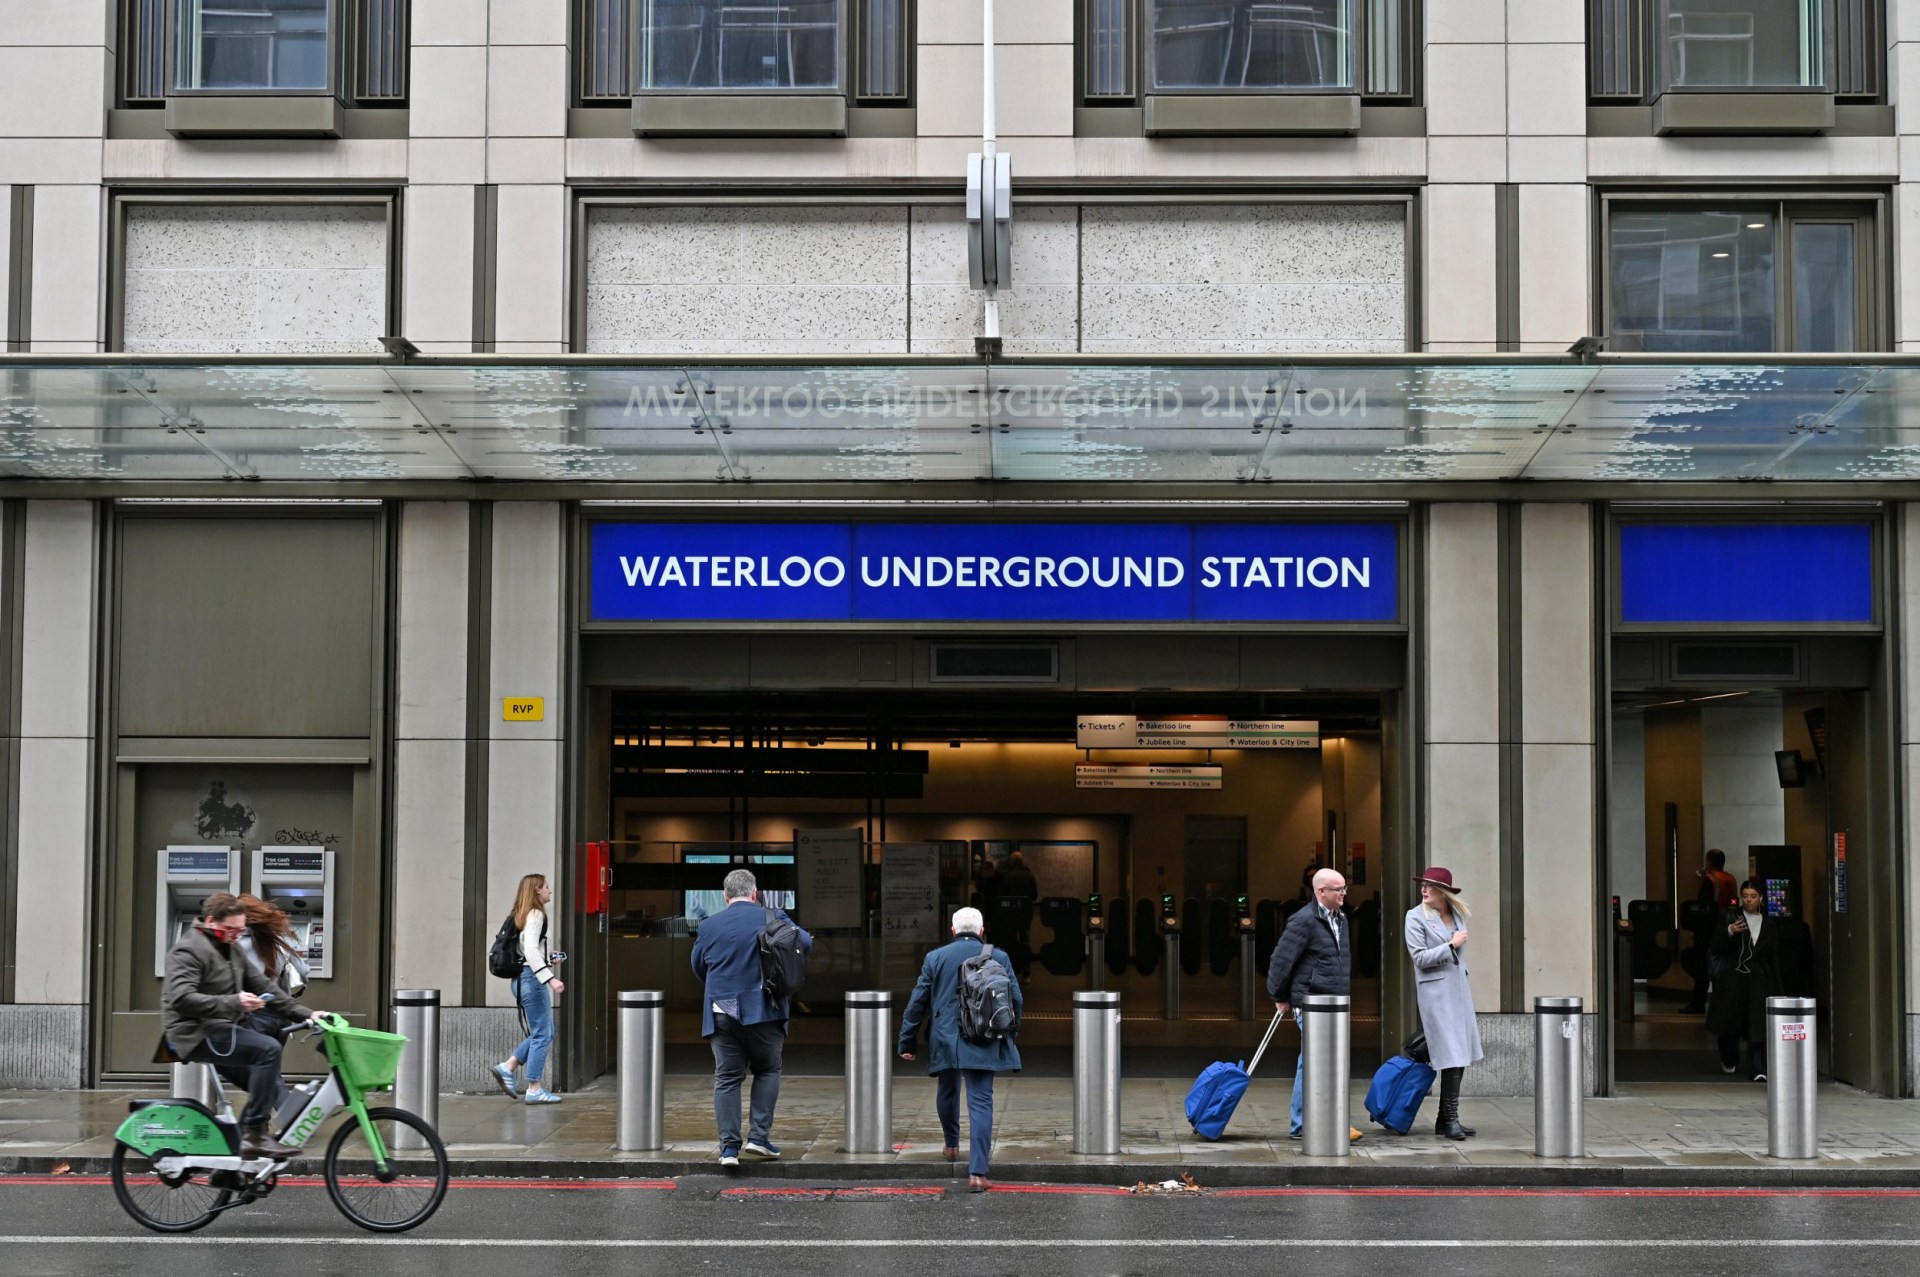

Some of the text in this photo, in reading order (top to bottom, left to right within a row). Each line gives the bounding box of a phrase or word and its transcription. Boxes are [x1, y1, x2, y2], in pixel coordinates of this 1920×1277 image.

[619, 555, 1370, 588] WATERLOO UNDERGROUND STATION
[512, 704, 534, 714] RVP
[1088, 722, 1116, 731] Tickets
[1145, 722, 1192, 730] Bakerloo line
[1237, 722, 1285, 730] Northern line
[1145, 738, 1187, 746] Jubilee line
[1237, 738, 1310, 748] Waterloo & City line
